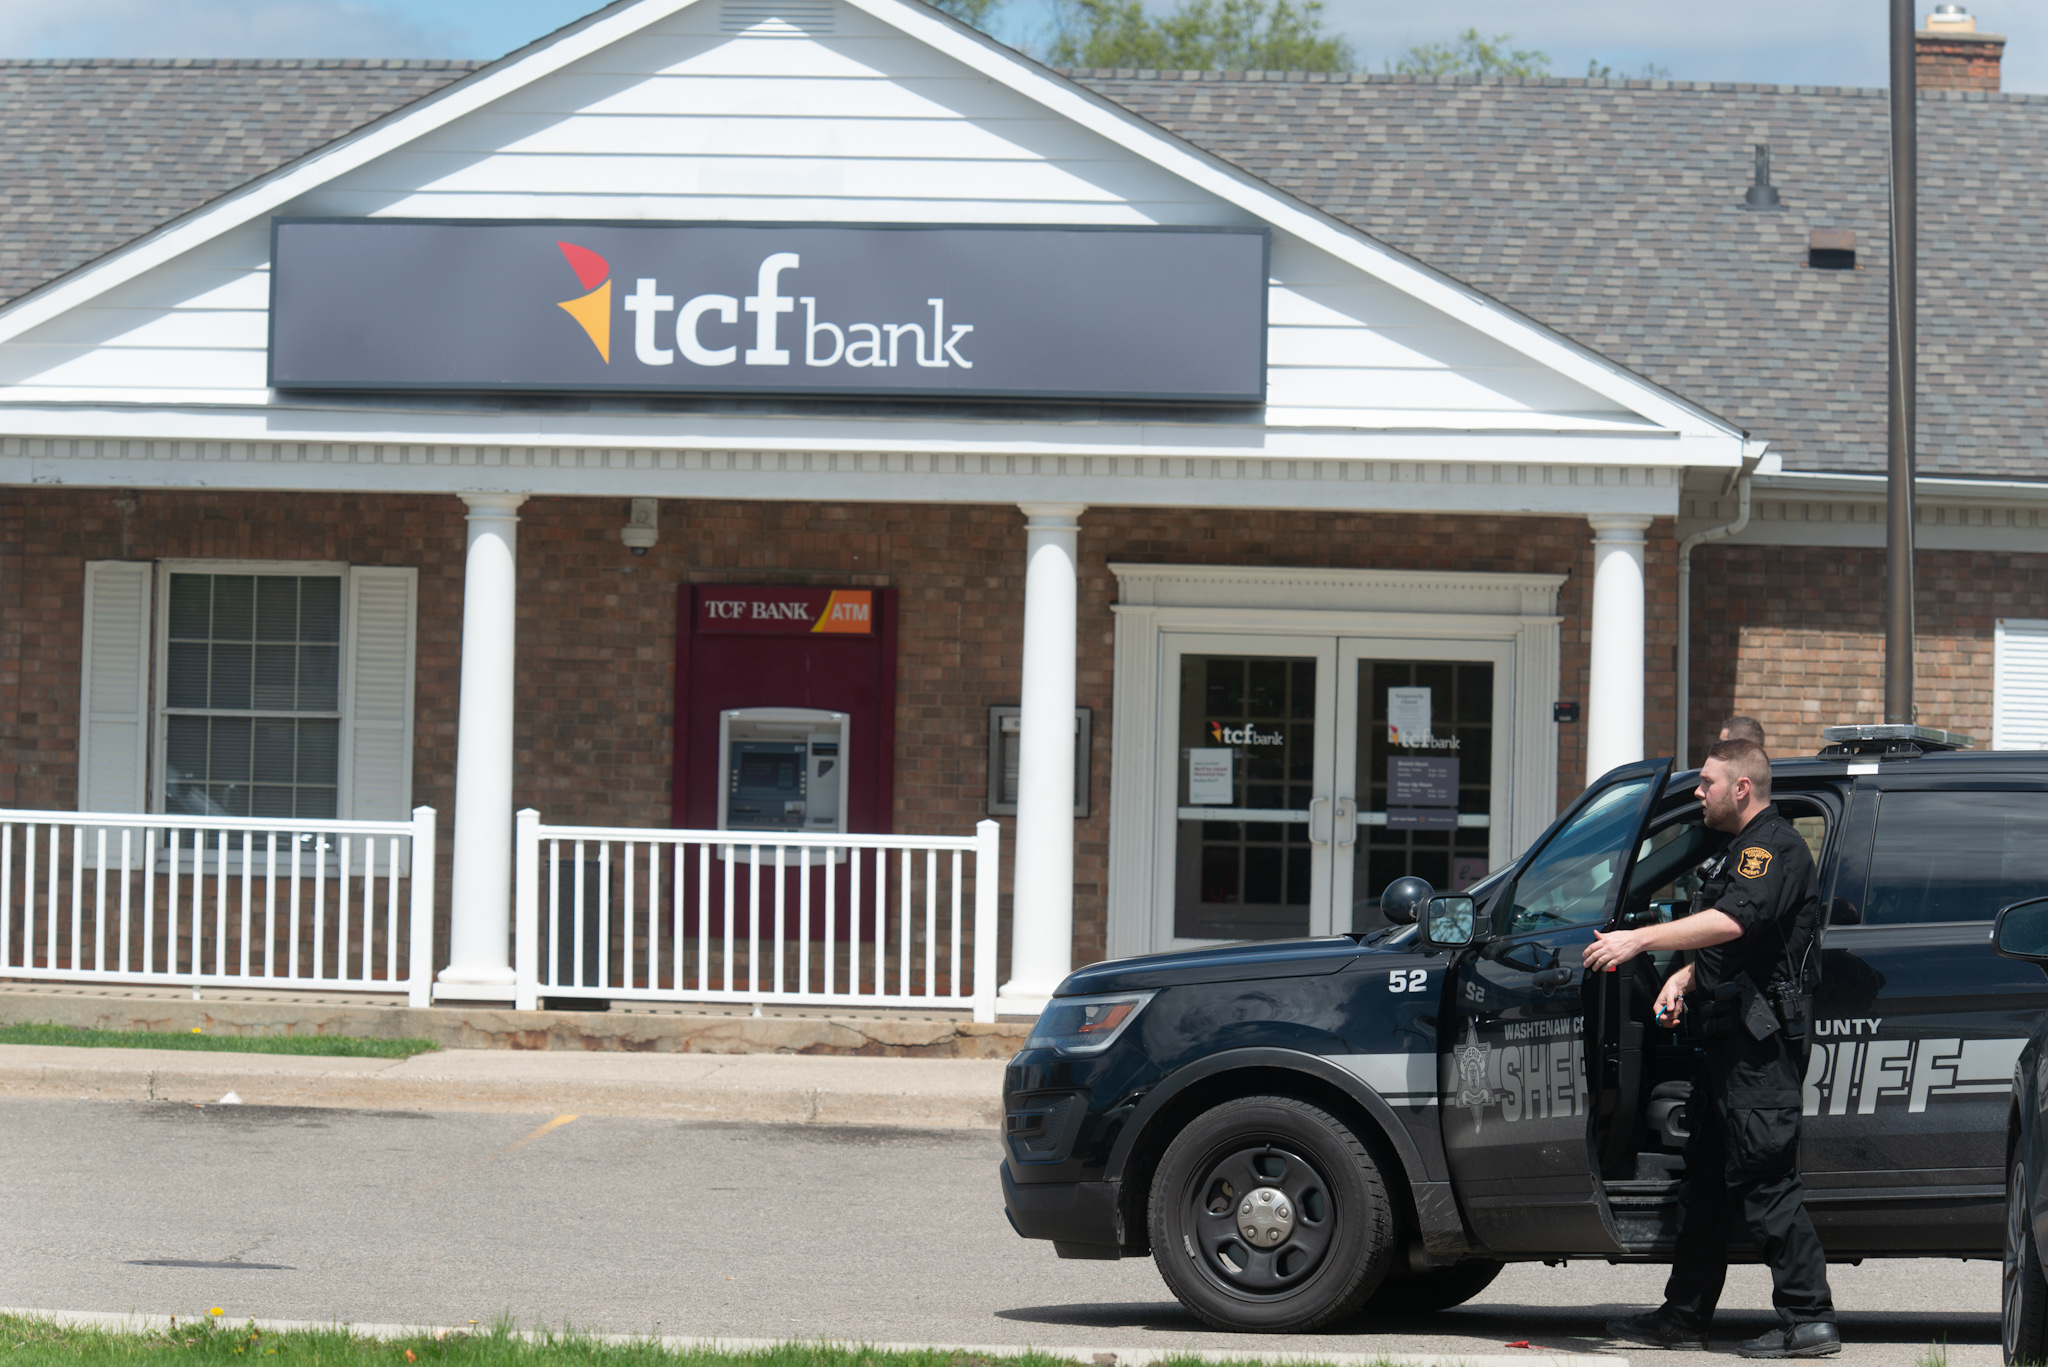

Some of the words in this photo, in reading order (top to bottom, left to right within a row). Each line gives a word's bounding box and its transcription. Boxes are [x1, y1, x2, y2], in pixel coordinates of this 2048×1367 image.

[705, 600, 747, 619] TCF
[751, 602, 810, 620] BANK
[831, 603, 869, 621] ATM
[1388, 969, 1428, 993] 52
[1504, 1018, 1571, 1040] WASHTENAW
[1815, 1018, 1883, 1036] UNTY
